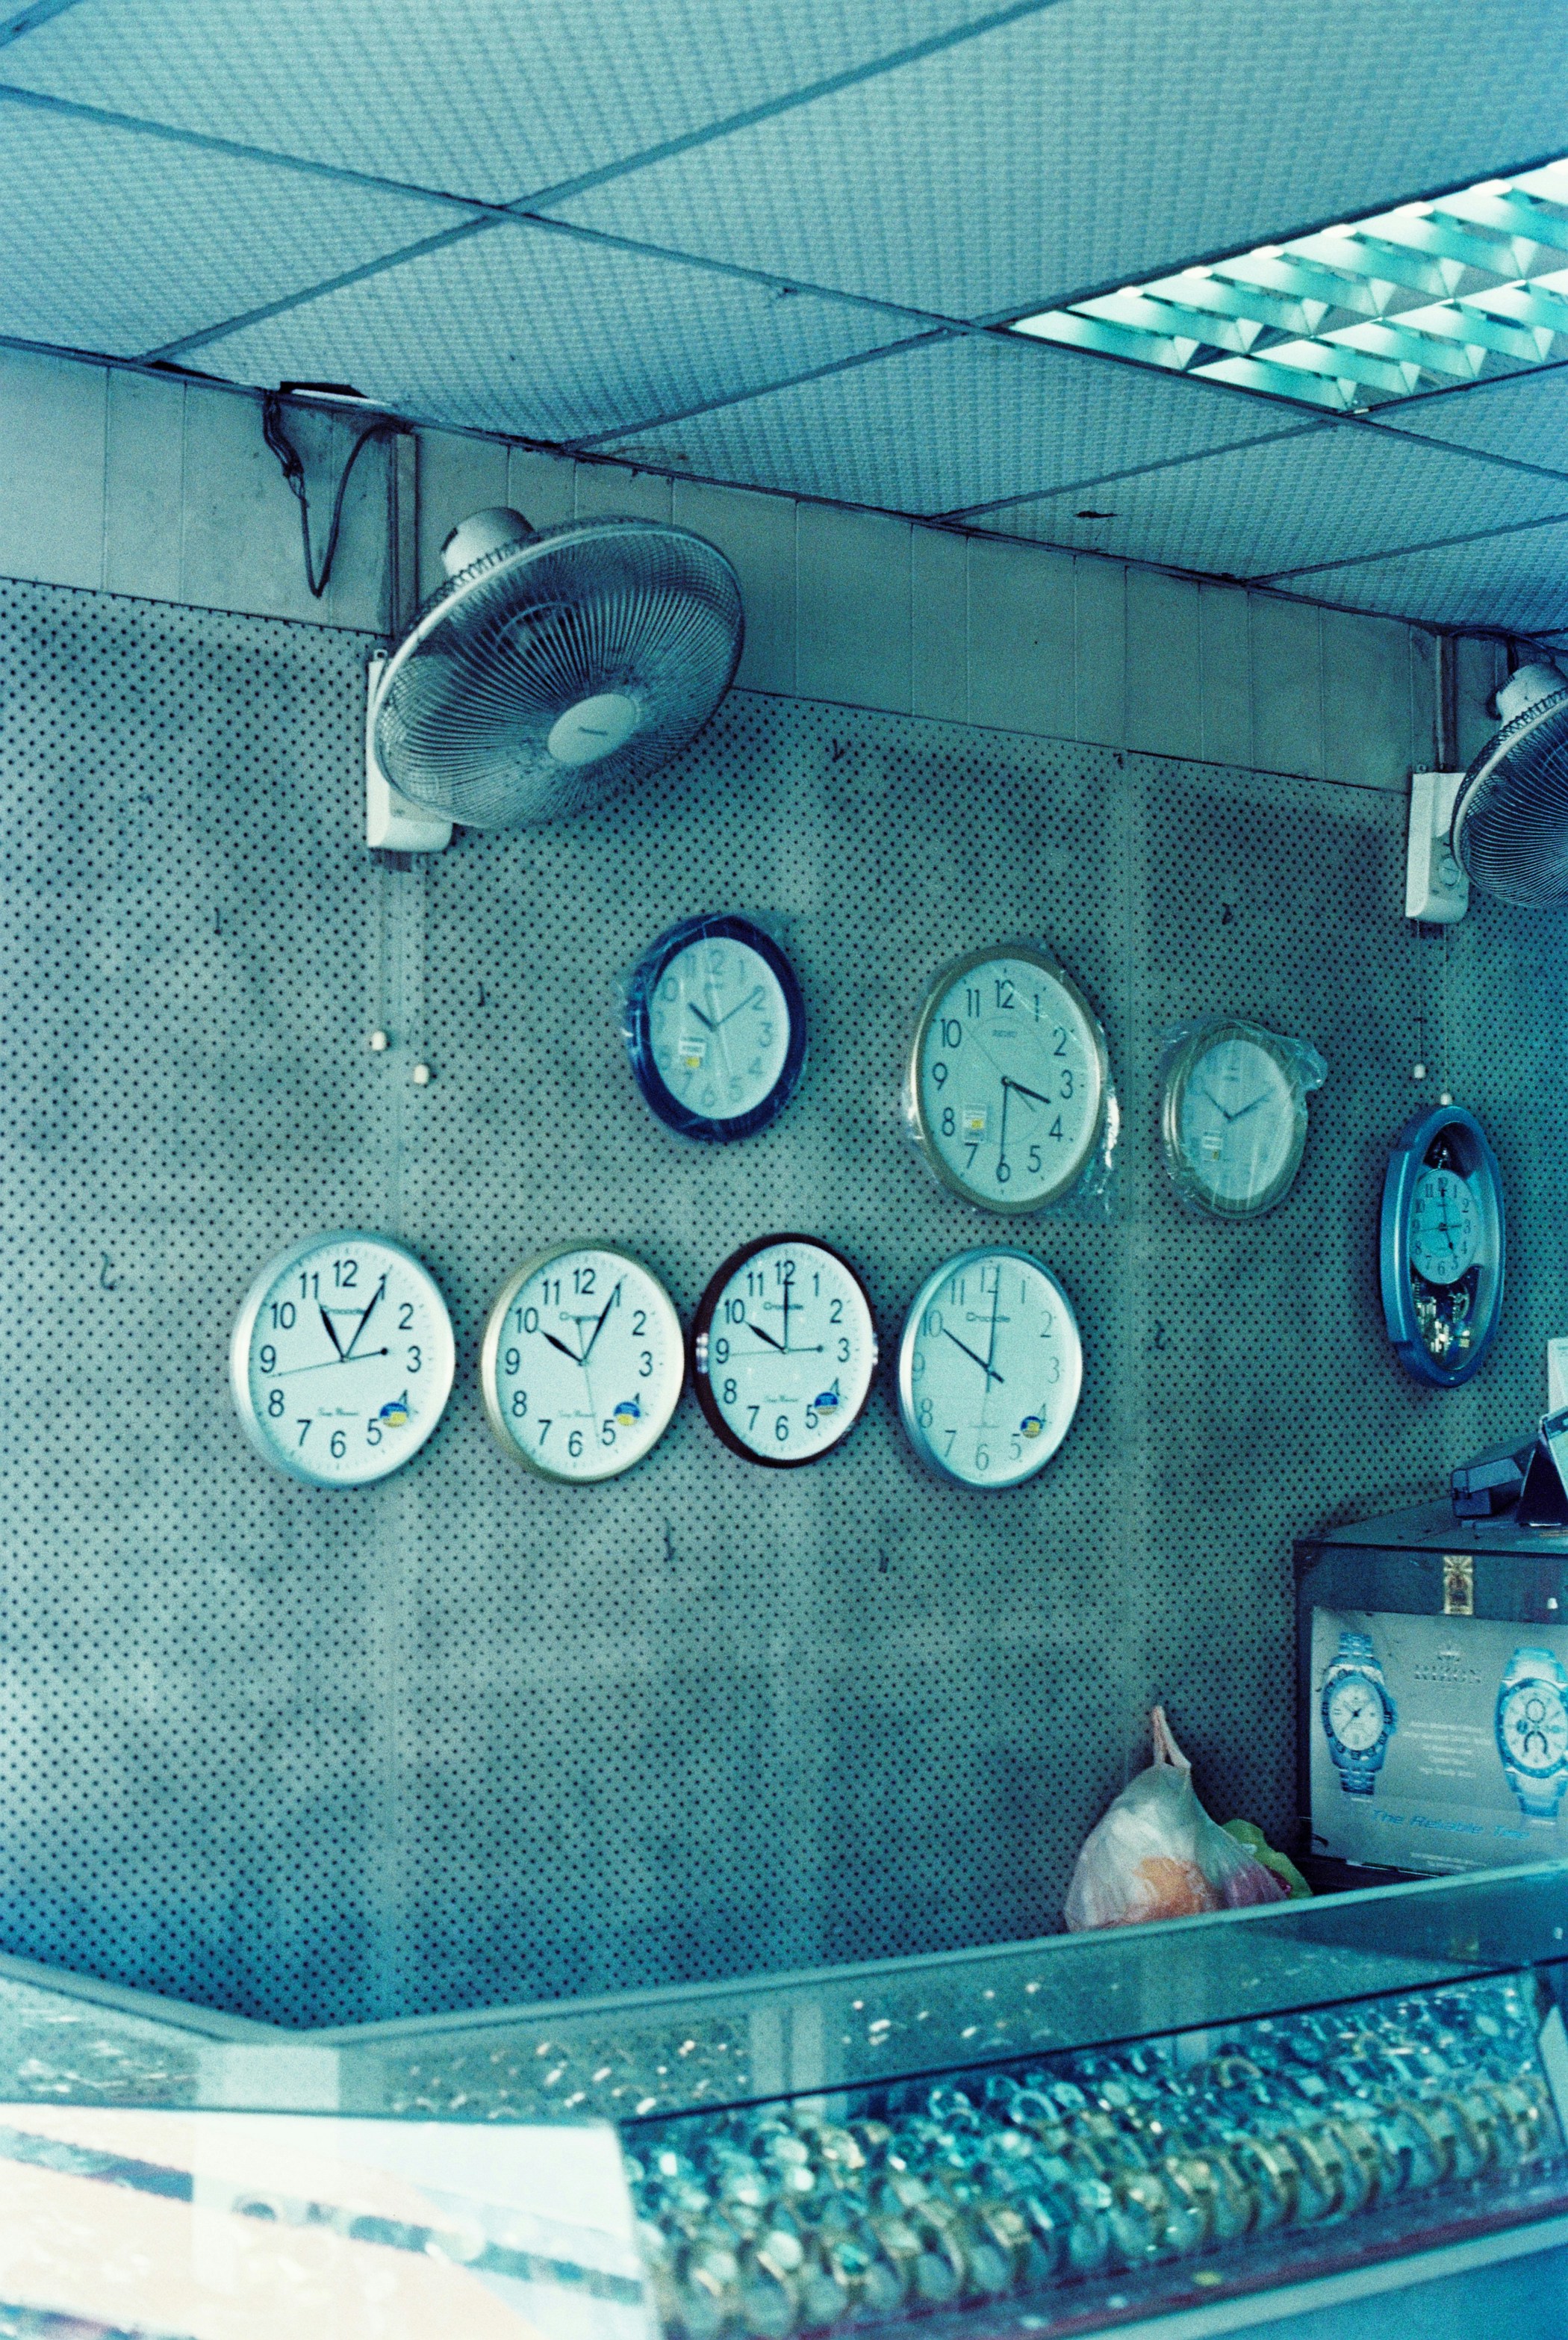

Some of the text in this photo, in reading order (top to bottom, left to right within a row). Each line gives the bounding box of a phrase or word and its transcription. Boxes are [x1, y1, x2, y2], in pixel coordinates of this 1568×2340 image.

[753, 985, 765, 1011] 2
[966, 988, 980, 1017] 11
[995, 979, 1014, 1008] 12
[1033, 994, 1039, 1022] 1
[759, 1022, 773, 1048] 3
[941, 1019, 962, 1048] 10
[1053, 1027, 1066, 1056] 2
[748, 1057, 764, 1075] 4
[933, 1062, 948, 1091] 9
[681, 1071, 692, 1095] 7
[701, 1082, 716, 1107] 6
[729, 1076, 743, 1102] 5
[1060, 1070, 1074, 1099] 3
[942, 1107, 955, 1137] 8
[1049, 1112, 1063, 1142] 4
[965, 1142, 979, 1168] 7
[1027, 1145, 1042, 1173] 5
[996, 1154, 1010, 1183] 6
[1462, 1198, 1469, 1213] 2
[333, 1260, 358, 1287] 12
[774, 1260, 796, 1285] 12
[1426, 1255, 1431, 1270] 7
[299, 1272, 319, 1299] 11
[379, 1273, 387, 1300] 1
[542, 1279, 560, 1305] 11
[573, 1268, 596, 1294] 12
[747, 1271, 764, 1297] 11
[813, 1272, 819, 1297] 1
[951, 1279, 965, 1306] 11
[1021, 1279, 1026, 1304] 1
[615, 1282, 621, 1308] 1
[271, 1302, 296, 1329] 10
[399, 1303, 414, 1329] 2
[515, 1307, 538, 1333] 10
[632, 1310, 647, 1336] 2
[724, 1299, 745, 1324] 10
[830, 1299, 843, 1323] 2
[923, 1309, 944, 1337] 10
[1040, 1310, 1052, 1338] 2
[261, 1345, 276, 1374] 9
[407, 1345, 422, 1373] 3
[505, 1348, 520, 1375] 9
[716, 1338, 729, 1364] 9
[837, 1337, 850, 1362] 3
[638, 1351, 653, 1377] 3
[912, 1351, 925, 1382] 9
[1048, 1356, 1060, 1384] 3
[723, 1379, 737, 1404] 8
[829, 1377, 841, 1397] 4
[268, 1389, 284, 1418] 8
[512, 1390, 527, 1417] 8
[919, 1397, 933, 1429] 8
[747, 1405, 759, 1430] 7
[775, 1415, 789, 1441] 6
[805, 1404, 818, 1430] 5
[296, 1419, 311, 1447] 7
[331, 1430, 346, 1458] 6
[367, 1418, 382, 1445] 5
[538, 1419, 552, 1445] 7
[568, 1431, 583, 1457] 6
[602, 1420, 616, 1446] 5
[945, 1429, 957, 1457] 7
[975, 1444, 989, 1471] 6
[1010, 1433, 1021, 1460] 5
